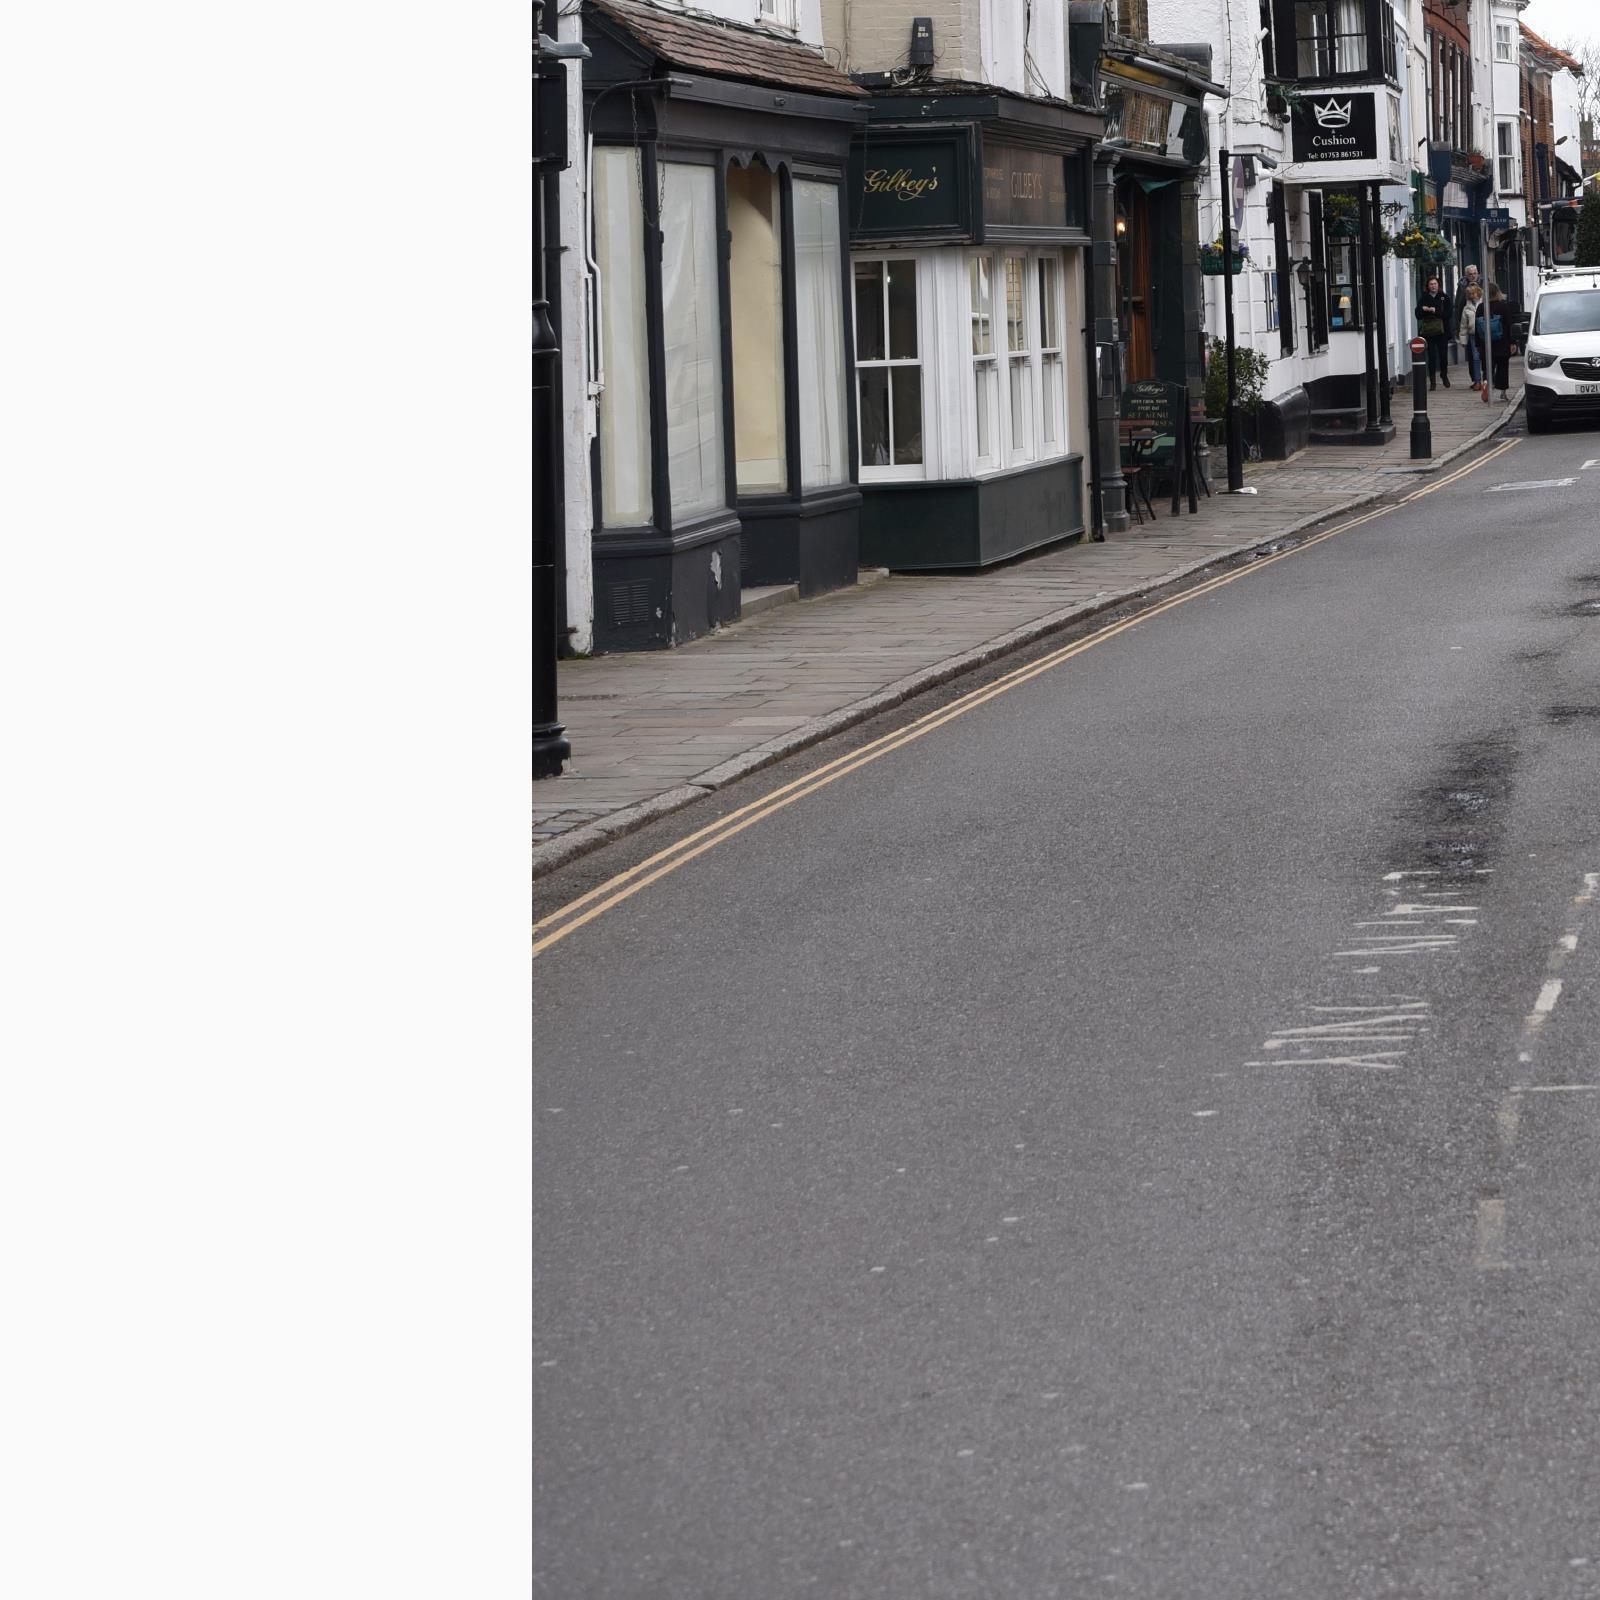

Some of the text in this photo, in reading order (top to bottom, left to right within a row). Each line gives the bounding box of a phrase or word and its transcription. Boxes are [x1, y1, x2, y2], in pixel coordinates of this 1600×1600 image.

[1312, 134, 1356, 147] Cushion
[1308, 152, 1319, 160] Tel:
[1320, 151, 1340, 159] 01753
[864, 165, 939, 201] Gilbey's
